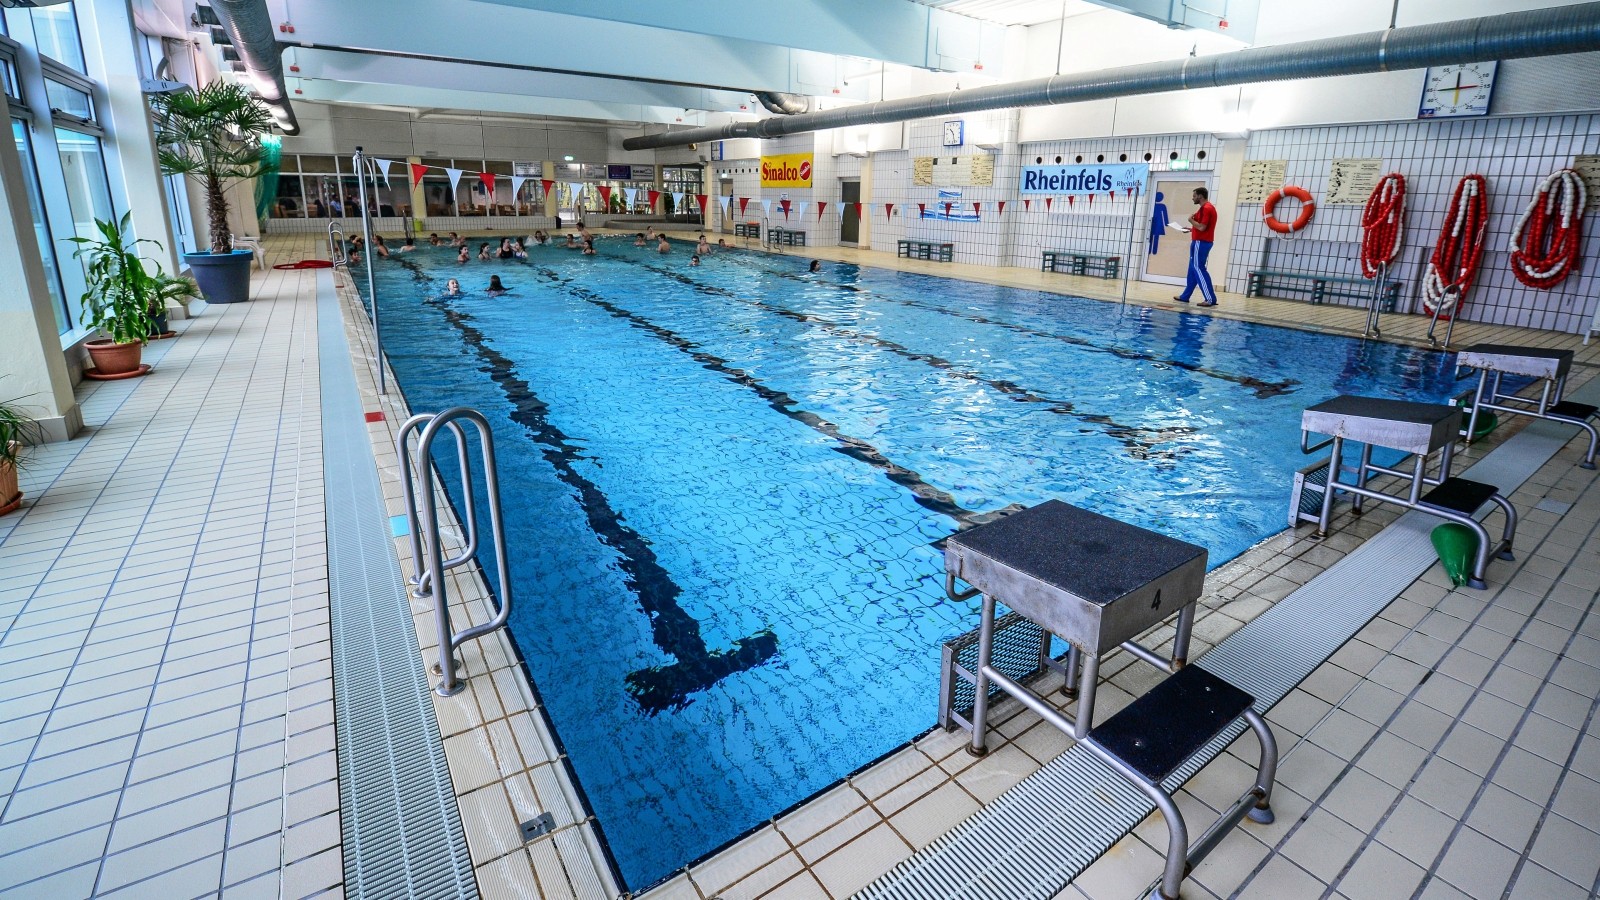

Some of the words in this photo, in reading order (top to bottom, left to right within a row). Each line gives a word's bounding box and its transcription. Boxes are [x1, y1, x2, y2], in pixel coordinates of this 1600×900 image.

[762, 161, 797, 181] Sinalco
[1024, 168, 1112, 191] Rheinfels
[1151, 588, 1161, 611] 4
